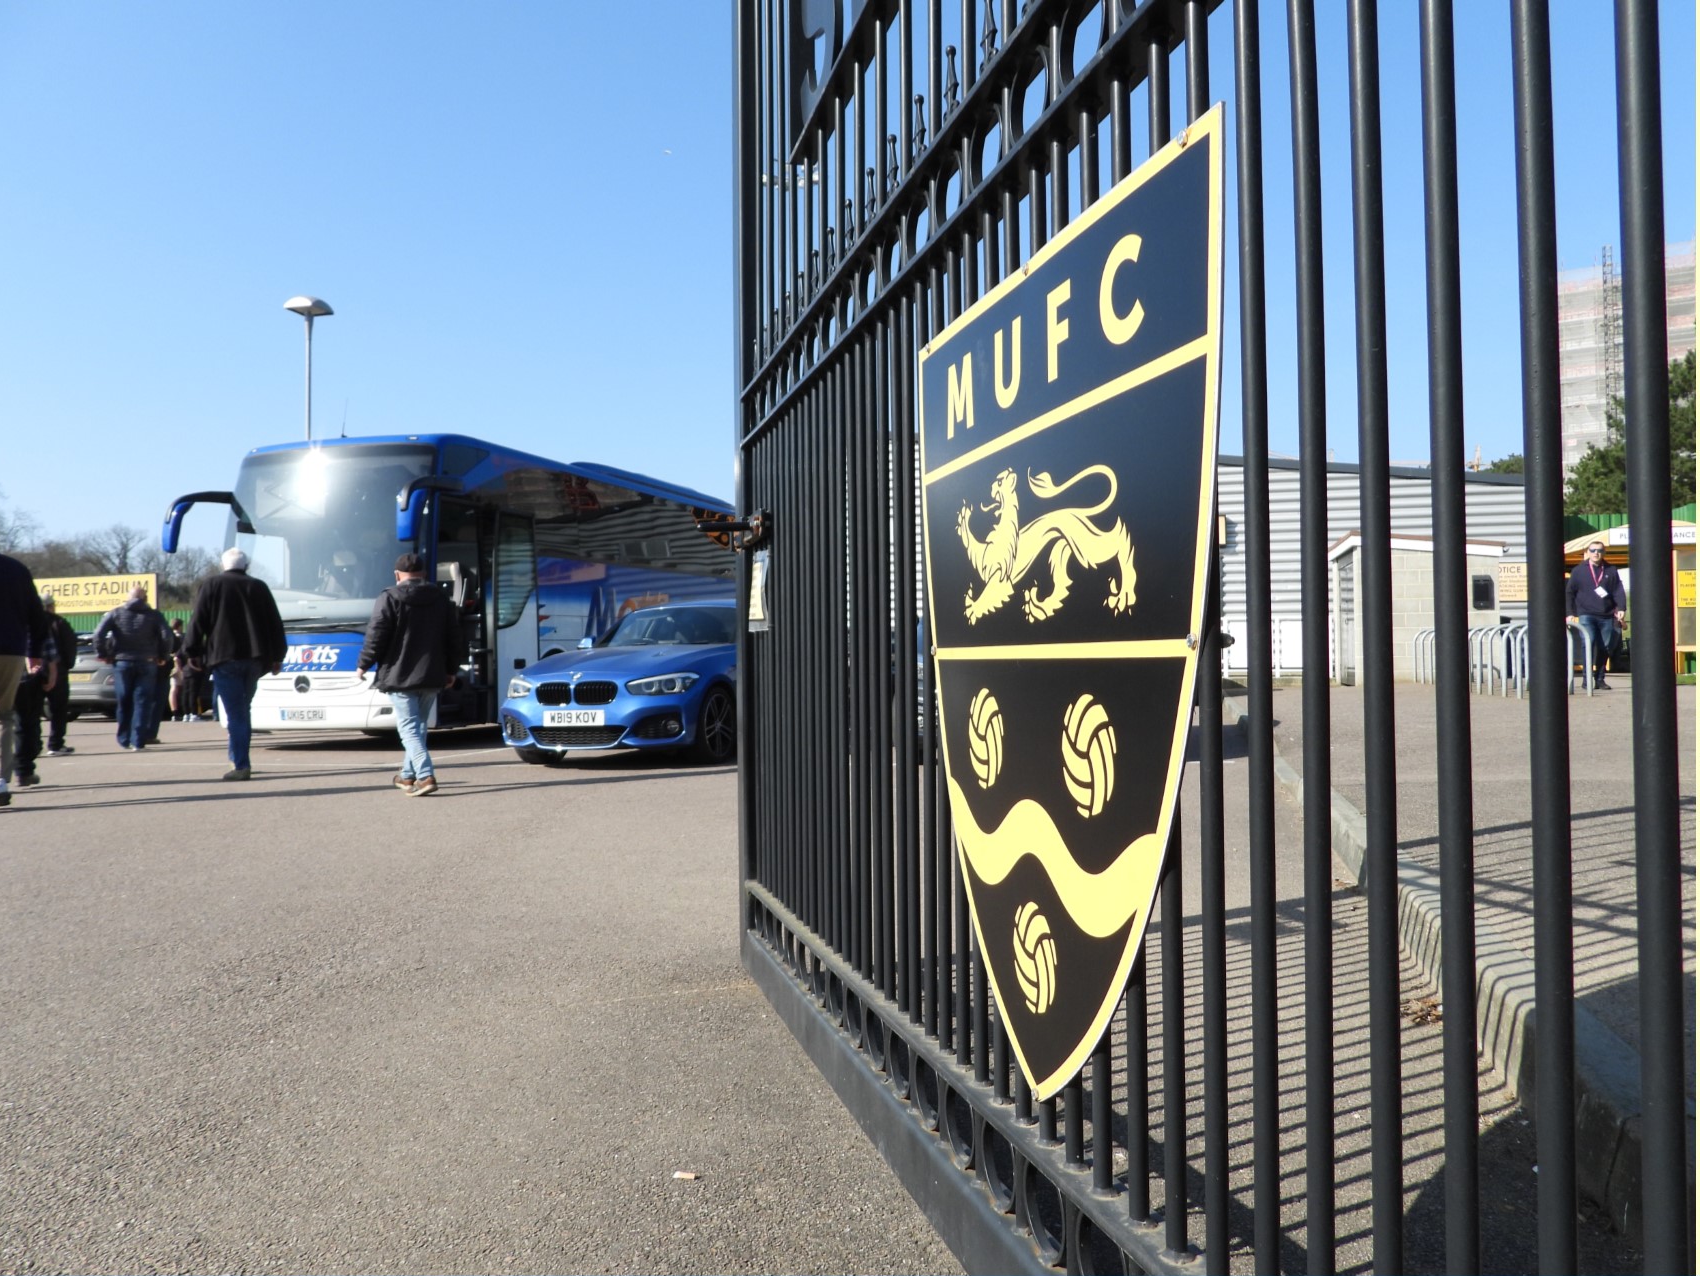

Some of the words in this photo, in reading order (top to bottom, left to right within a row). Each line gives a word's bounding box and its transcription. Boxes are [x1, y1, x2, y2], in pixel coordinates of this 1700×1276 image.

[947, 232, 1145, 440] MUFC
[283, 645, 341, 664] Motts
[306, 710, 324, 720] CRU
[550, 712, 573, 724] WB19
[575, 712, 597, 723] KOV
